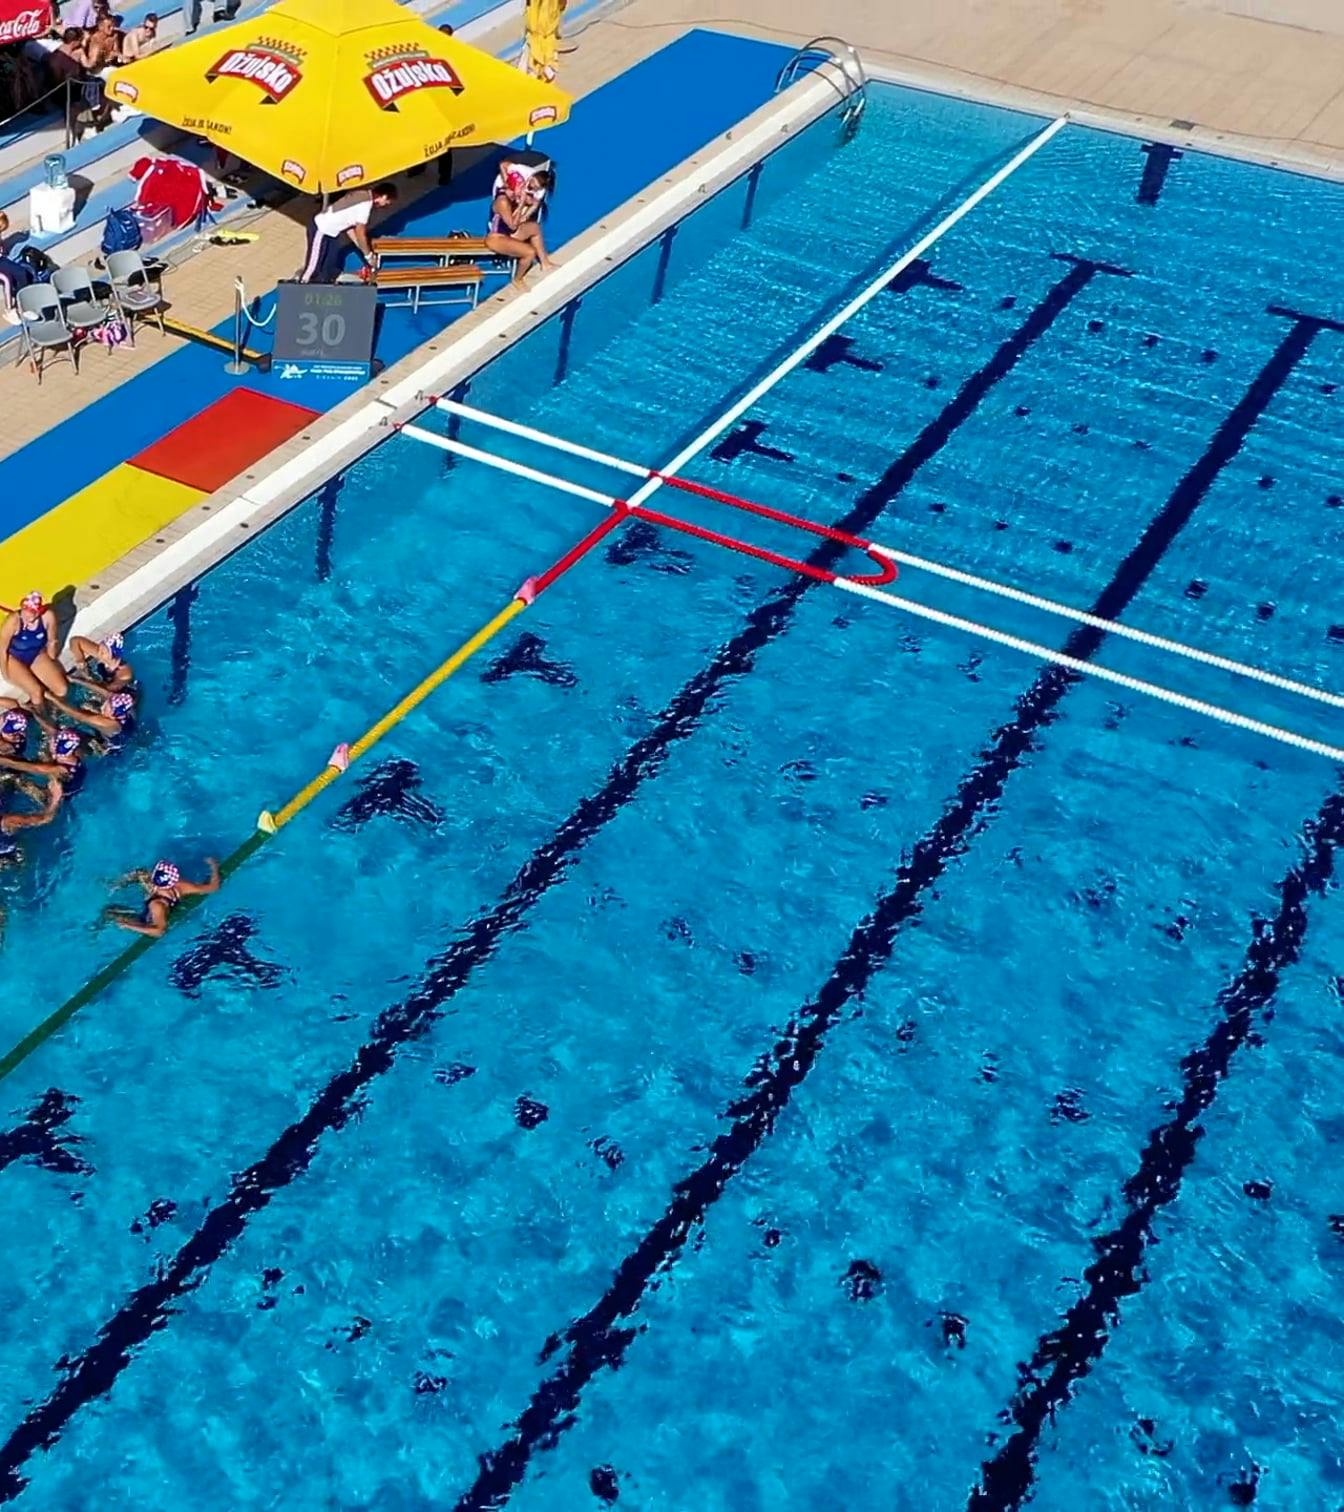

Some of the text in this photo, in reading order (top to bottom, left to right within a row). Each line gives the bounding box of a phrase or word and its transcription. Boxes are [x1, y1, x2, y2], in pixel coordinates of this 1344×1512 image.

[219, 52, 293, 93] Ožujsko
[371, 61, 452, 100] Ožujsko
[296, 312, 346, 346] 30
